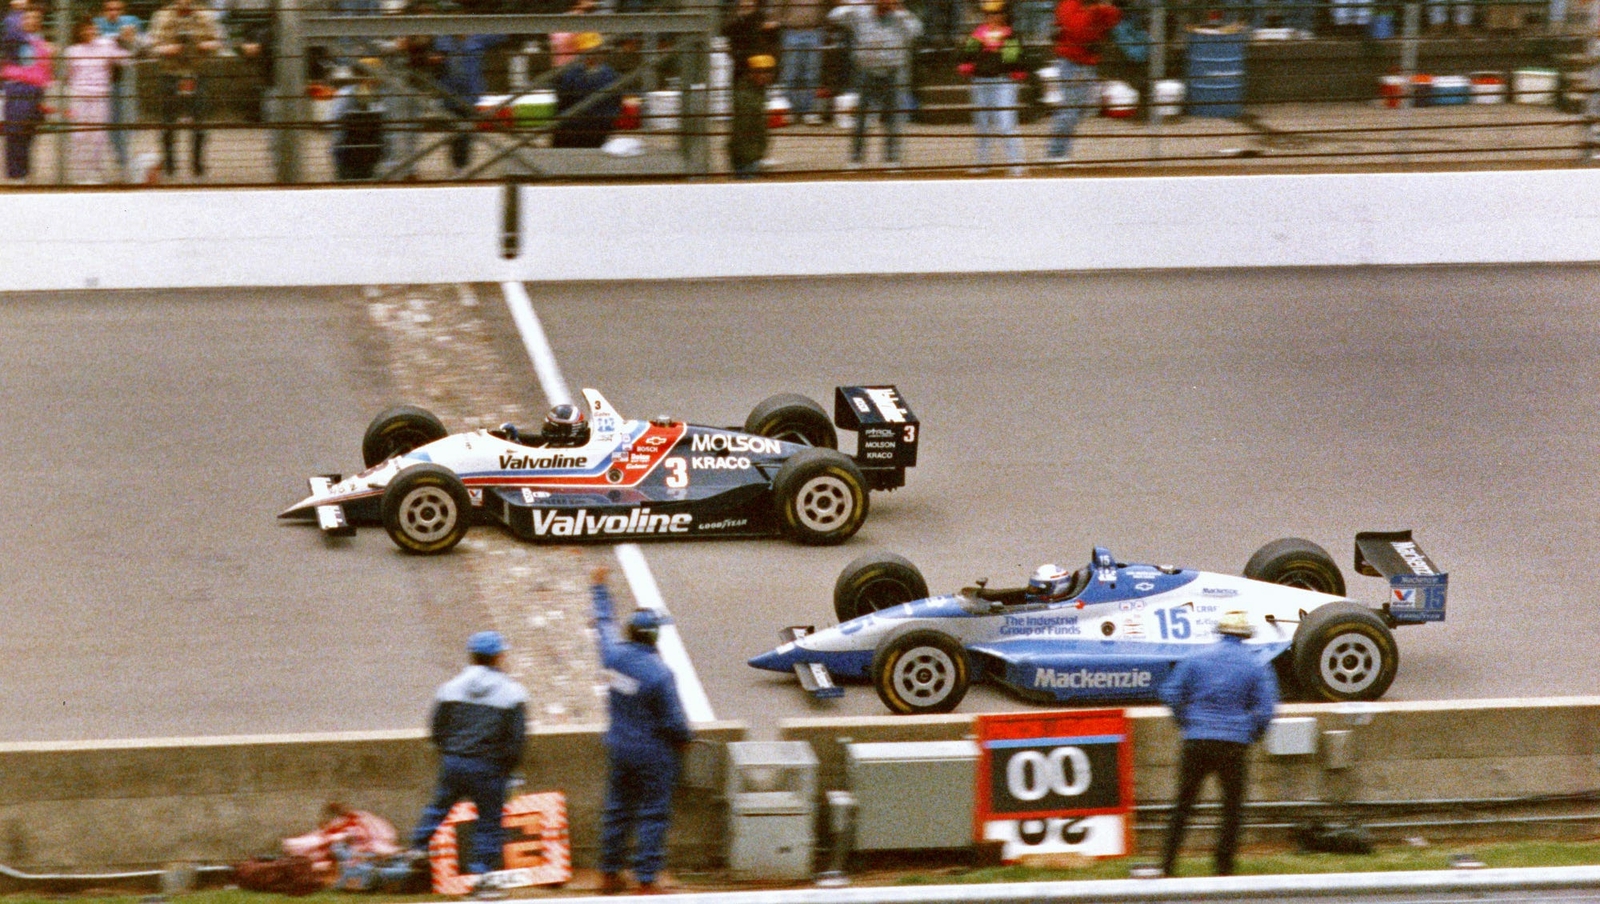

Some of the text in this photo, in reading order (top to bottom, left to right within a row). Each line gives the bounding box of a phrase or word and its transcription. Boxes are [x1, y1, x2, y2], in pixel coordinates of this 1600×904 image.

[594, 400, 602, 410] 3
[904, 425, 915, 442] 3
[691, 434, 781, 455] MOLSON
[865, 441, 896, 449] MOLSON
[499, 453, 588, 471] Valvoline
[691, 456, 751, 471] KRACO
[866, 452, 894, 460] KRACO
[664, 457, 689, 489] 3
[532, 508, 692, 536] Valvoline
[698, 519, 748, 530] GOODYEAR
[1099, 555, 1111, 566] 15
[1004, 615, 1078, 626] The Industrial
[1154, 608, 1192, 640] 15
[1000, 625, 1081, 636] Group of Funds
[1034, 669, 1151, 688] Mackenzie
[1006, 746, 1092, 801] 00
